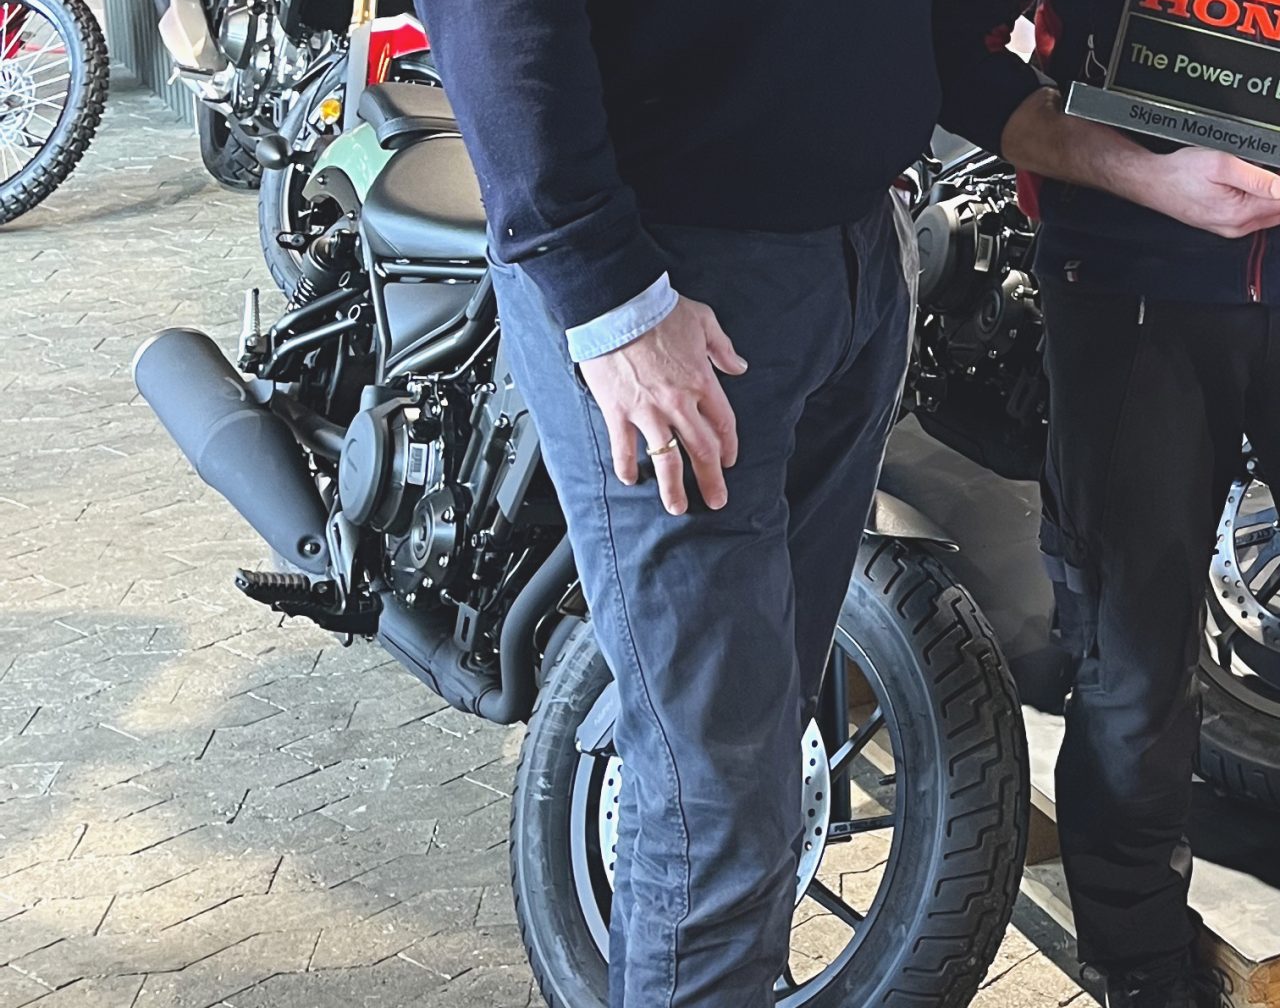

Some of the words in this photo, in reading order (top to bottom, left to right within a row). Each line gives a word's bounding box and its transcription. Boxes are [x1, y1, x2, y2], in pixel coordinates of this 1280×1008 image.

[1131, 43, 1168, 69] The
[1174, 54, 1243, 89] Power
[1247, 77, 1273, 96] of
[1129, 105, 1178, 130] Skjern
[1181, 116, 1278, 155] Motorcykler
